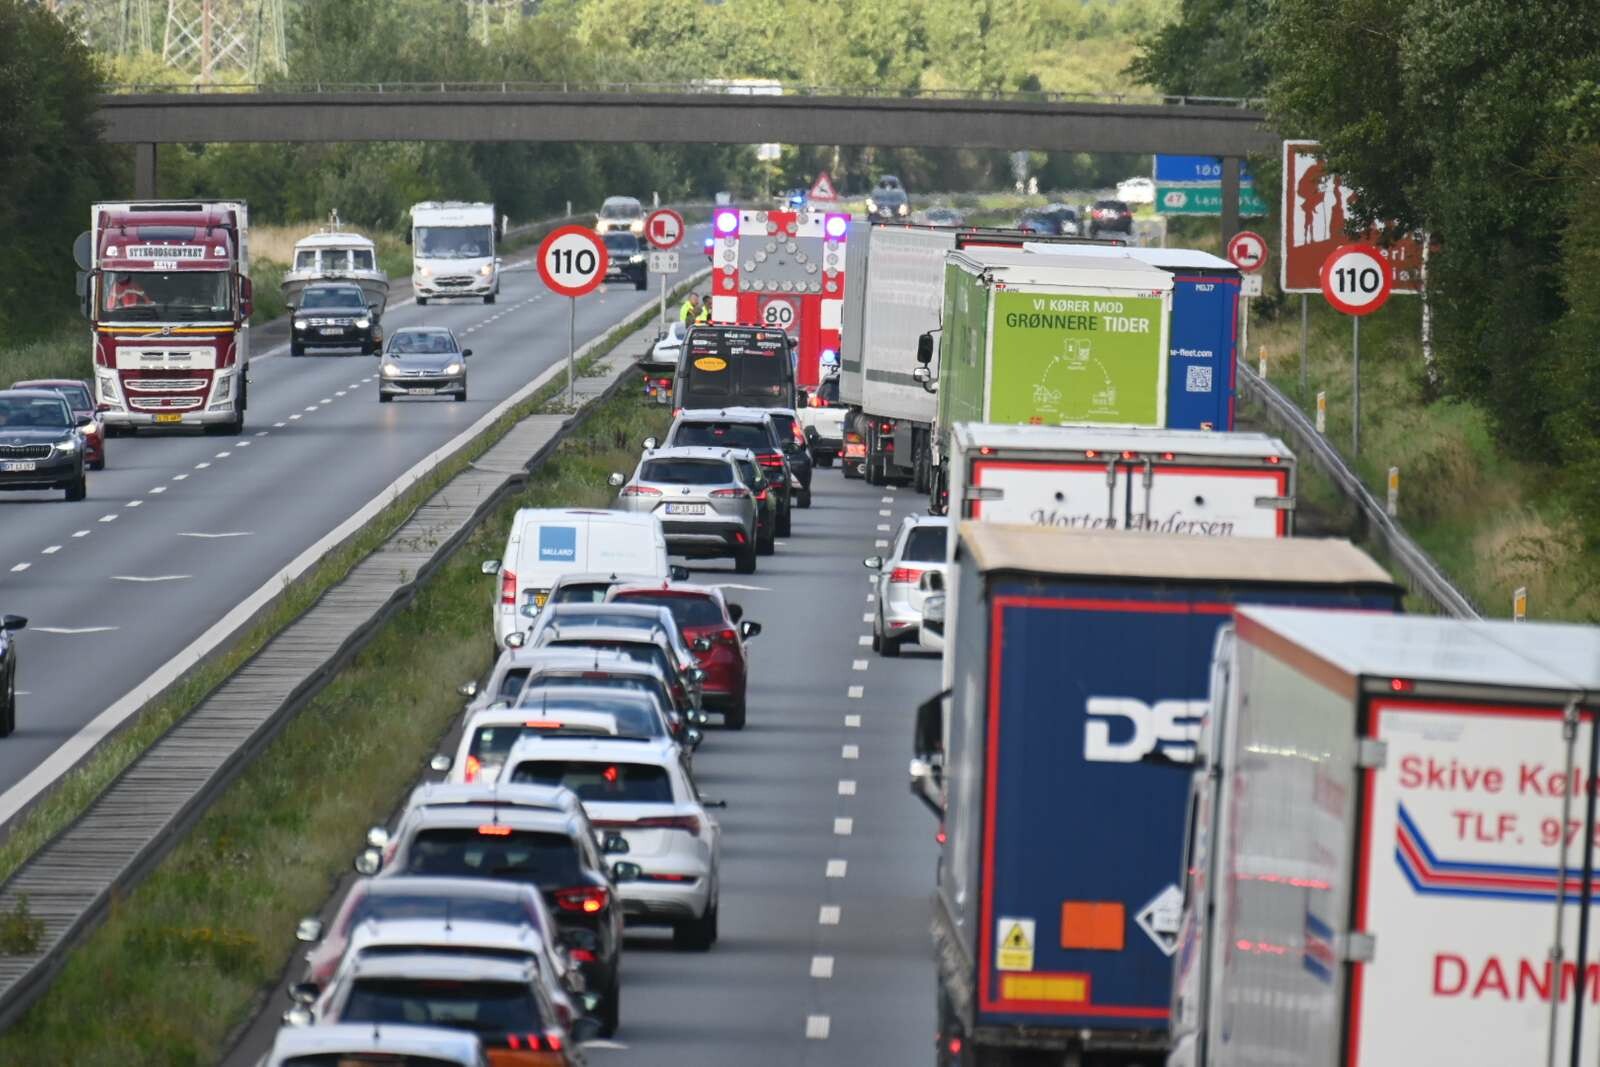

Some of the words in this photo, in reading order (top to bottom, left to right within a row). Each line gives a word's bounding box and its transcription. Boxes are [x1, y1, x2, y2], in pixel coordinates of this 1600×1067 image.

[552, 249, 596, 275] 110
[1335, 267, 1380, 293] 110
[765, 307, 792, 323] 80
[1033, 299, 1045, 310] VI
[1050, 299, 1090, 313] KØRER
[1094, 301, 1124, 313] MOD
[1006, 312, 1098, 331] GRØNNERE
[1103, 316, 1150, 334] TIDER
[1030, 509, 1119, 531] Morten
[1129, 510, 1234, 537] Andersen
[1400, 753, 1504, 793] Skive
[1452, 809, 1525, 845] TLF.
